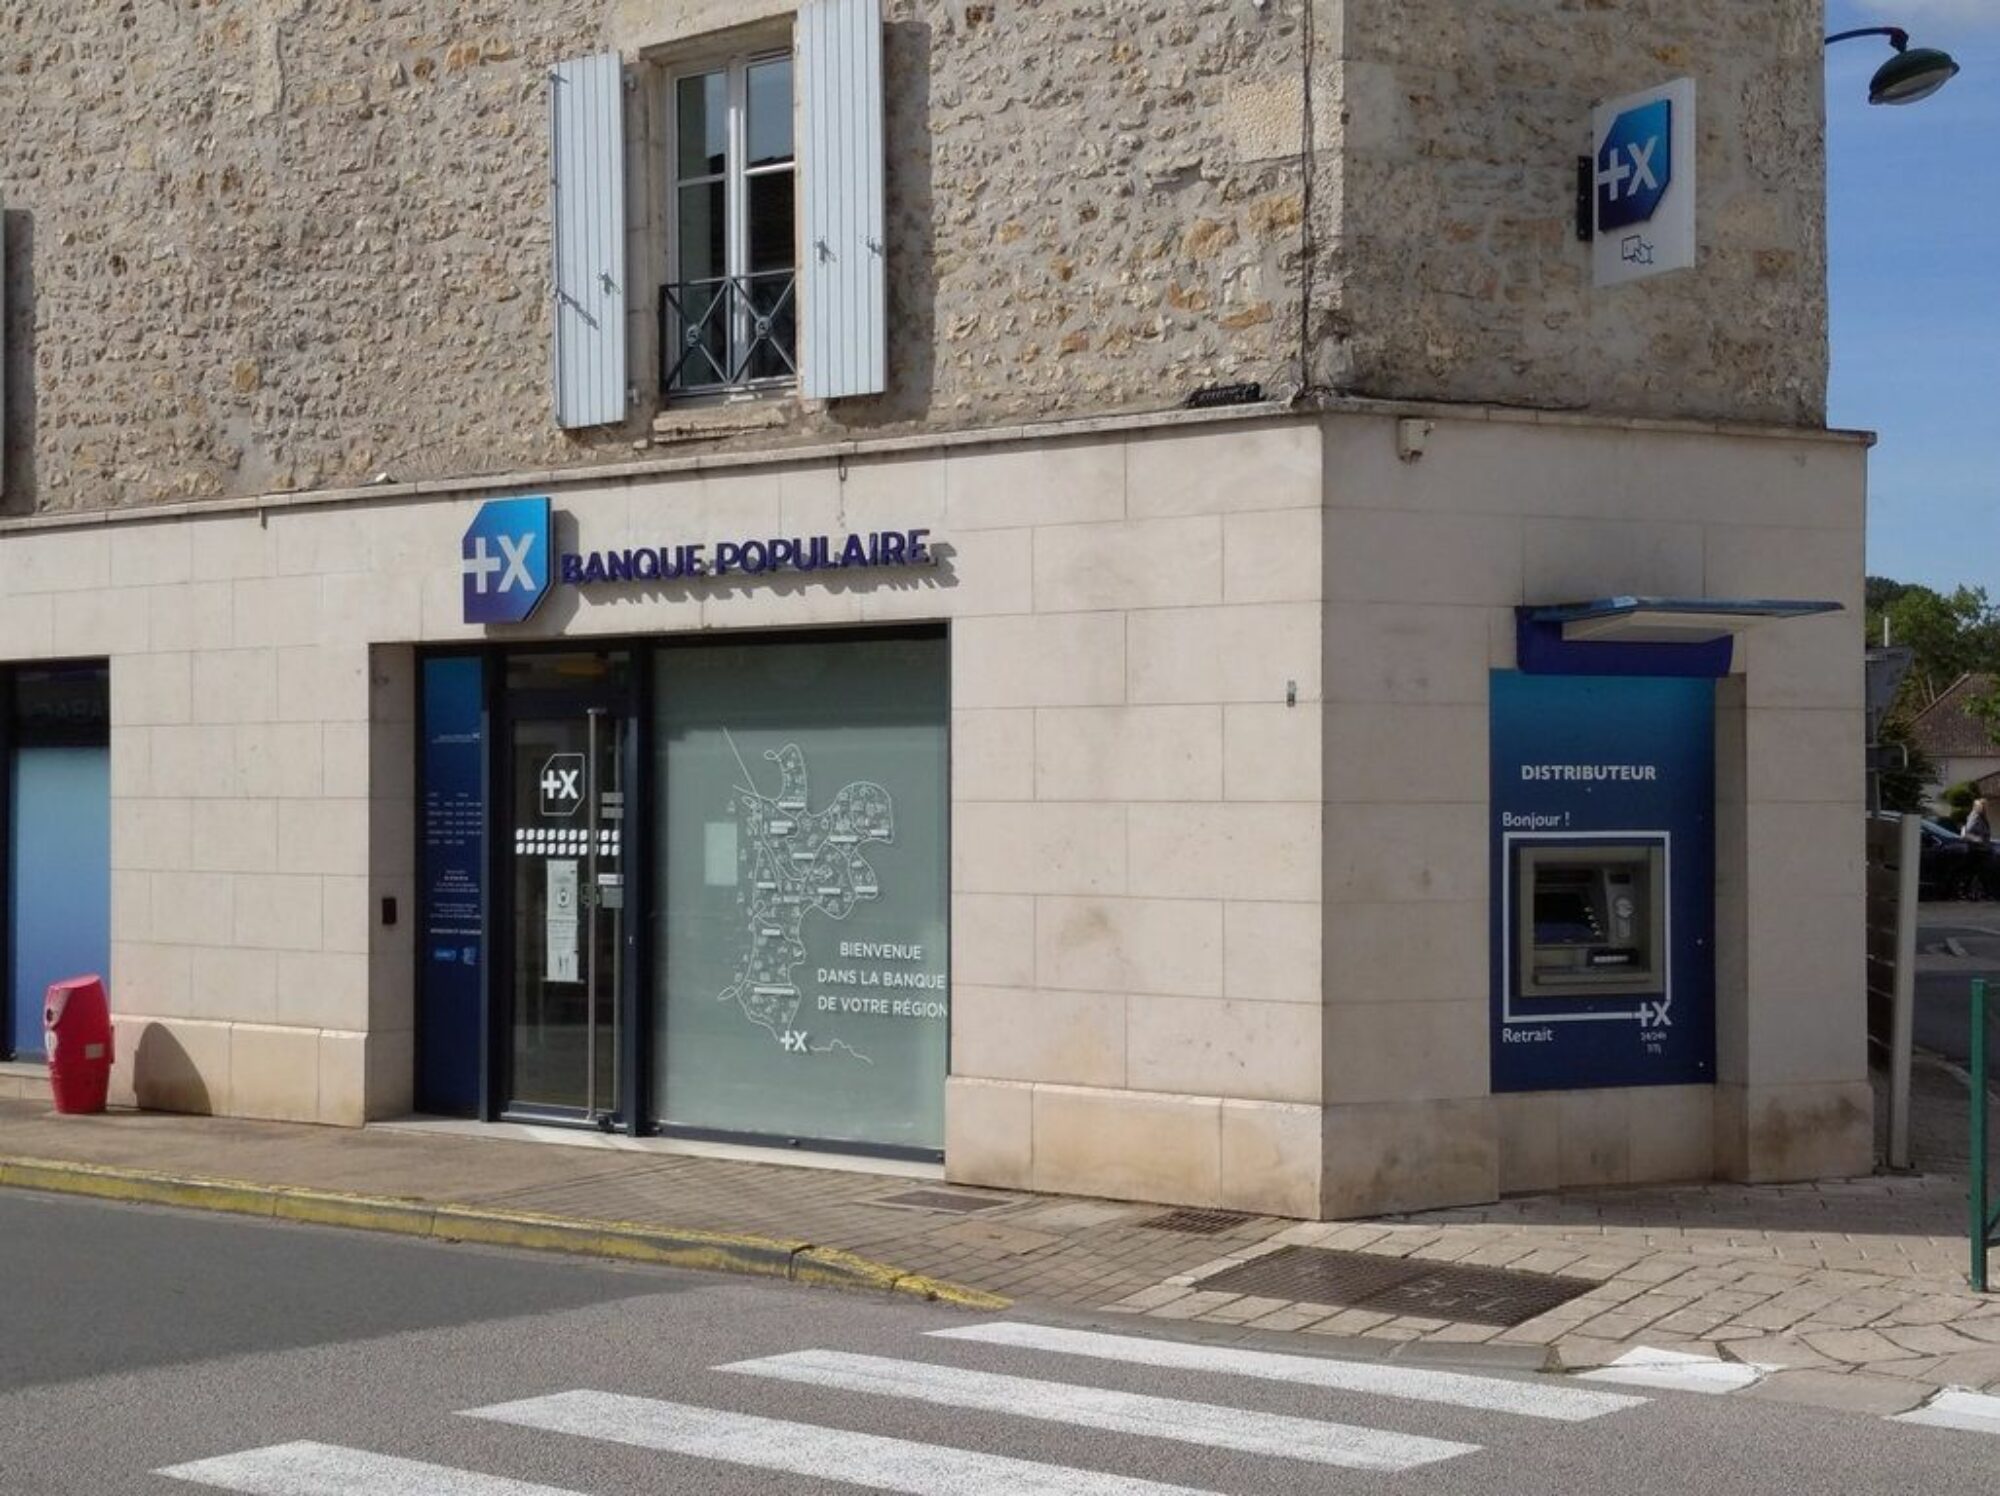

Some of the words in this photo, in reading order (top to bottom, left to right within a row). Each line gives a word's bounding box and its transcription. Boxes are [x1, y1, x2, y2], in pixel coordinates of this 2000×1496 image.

[561, 544, 706, 584] BANQUE
[716, 529, 938, 575] POPULAIRE
[1521, 765, 1656, 781] DISTRIBUTEUR
[1502, 811, 1561, 830] Bonjour
[840, 941, 922, 960] BIENVENUE
[817, 967, 857, 985] DANS
[860, 969, 880, 985] LA
[882, 971, 946, 989] BANQUE
[818, 995, 837, 1011] DE
[840, 997, 889, 1014] VOTRE
[1502, 1027, 1553, 1043] Retrait
